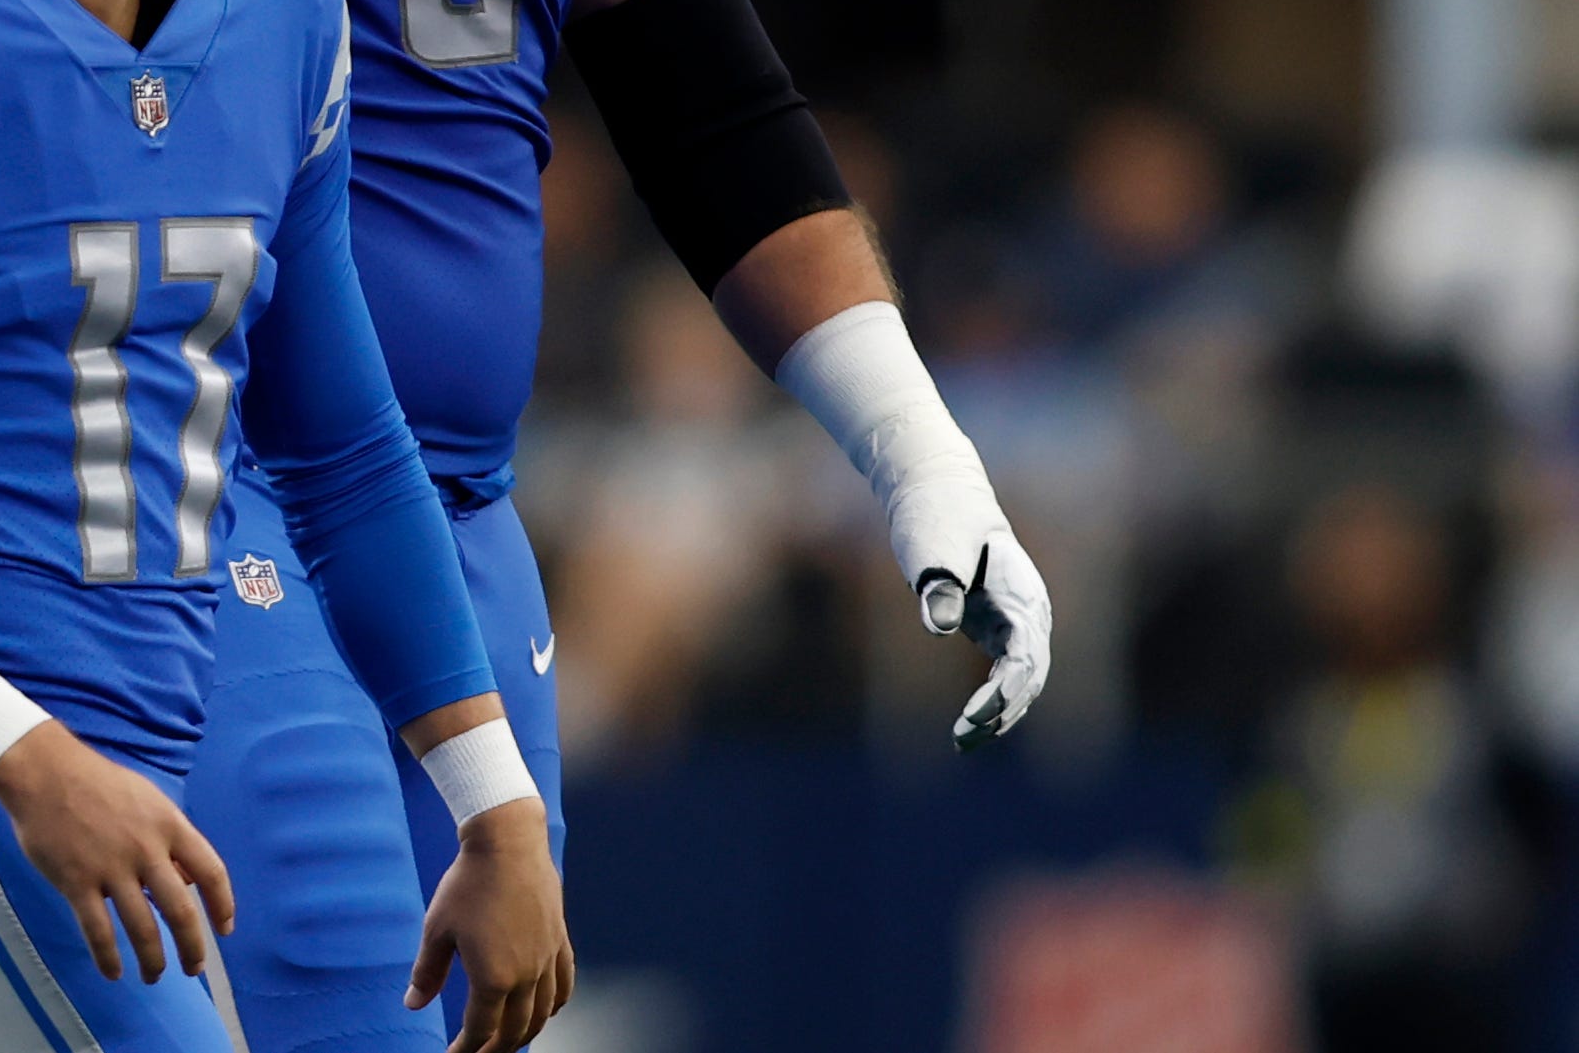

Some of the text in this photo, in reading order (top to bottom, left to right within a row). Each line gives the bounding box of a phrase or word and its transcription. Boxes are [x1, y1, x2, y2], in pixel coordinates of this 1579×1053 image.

[138, 99, 165, 123] NFL
[69, 216, 261, 585] 17
[241, 578, 278, 599] NFL
